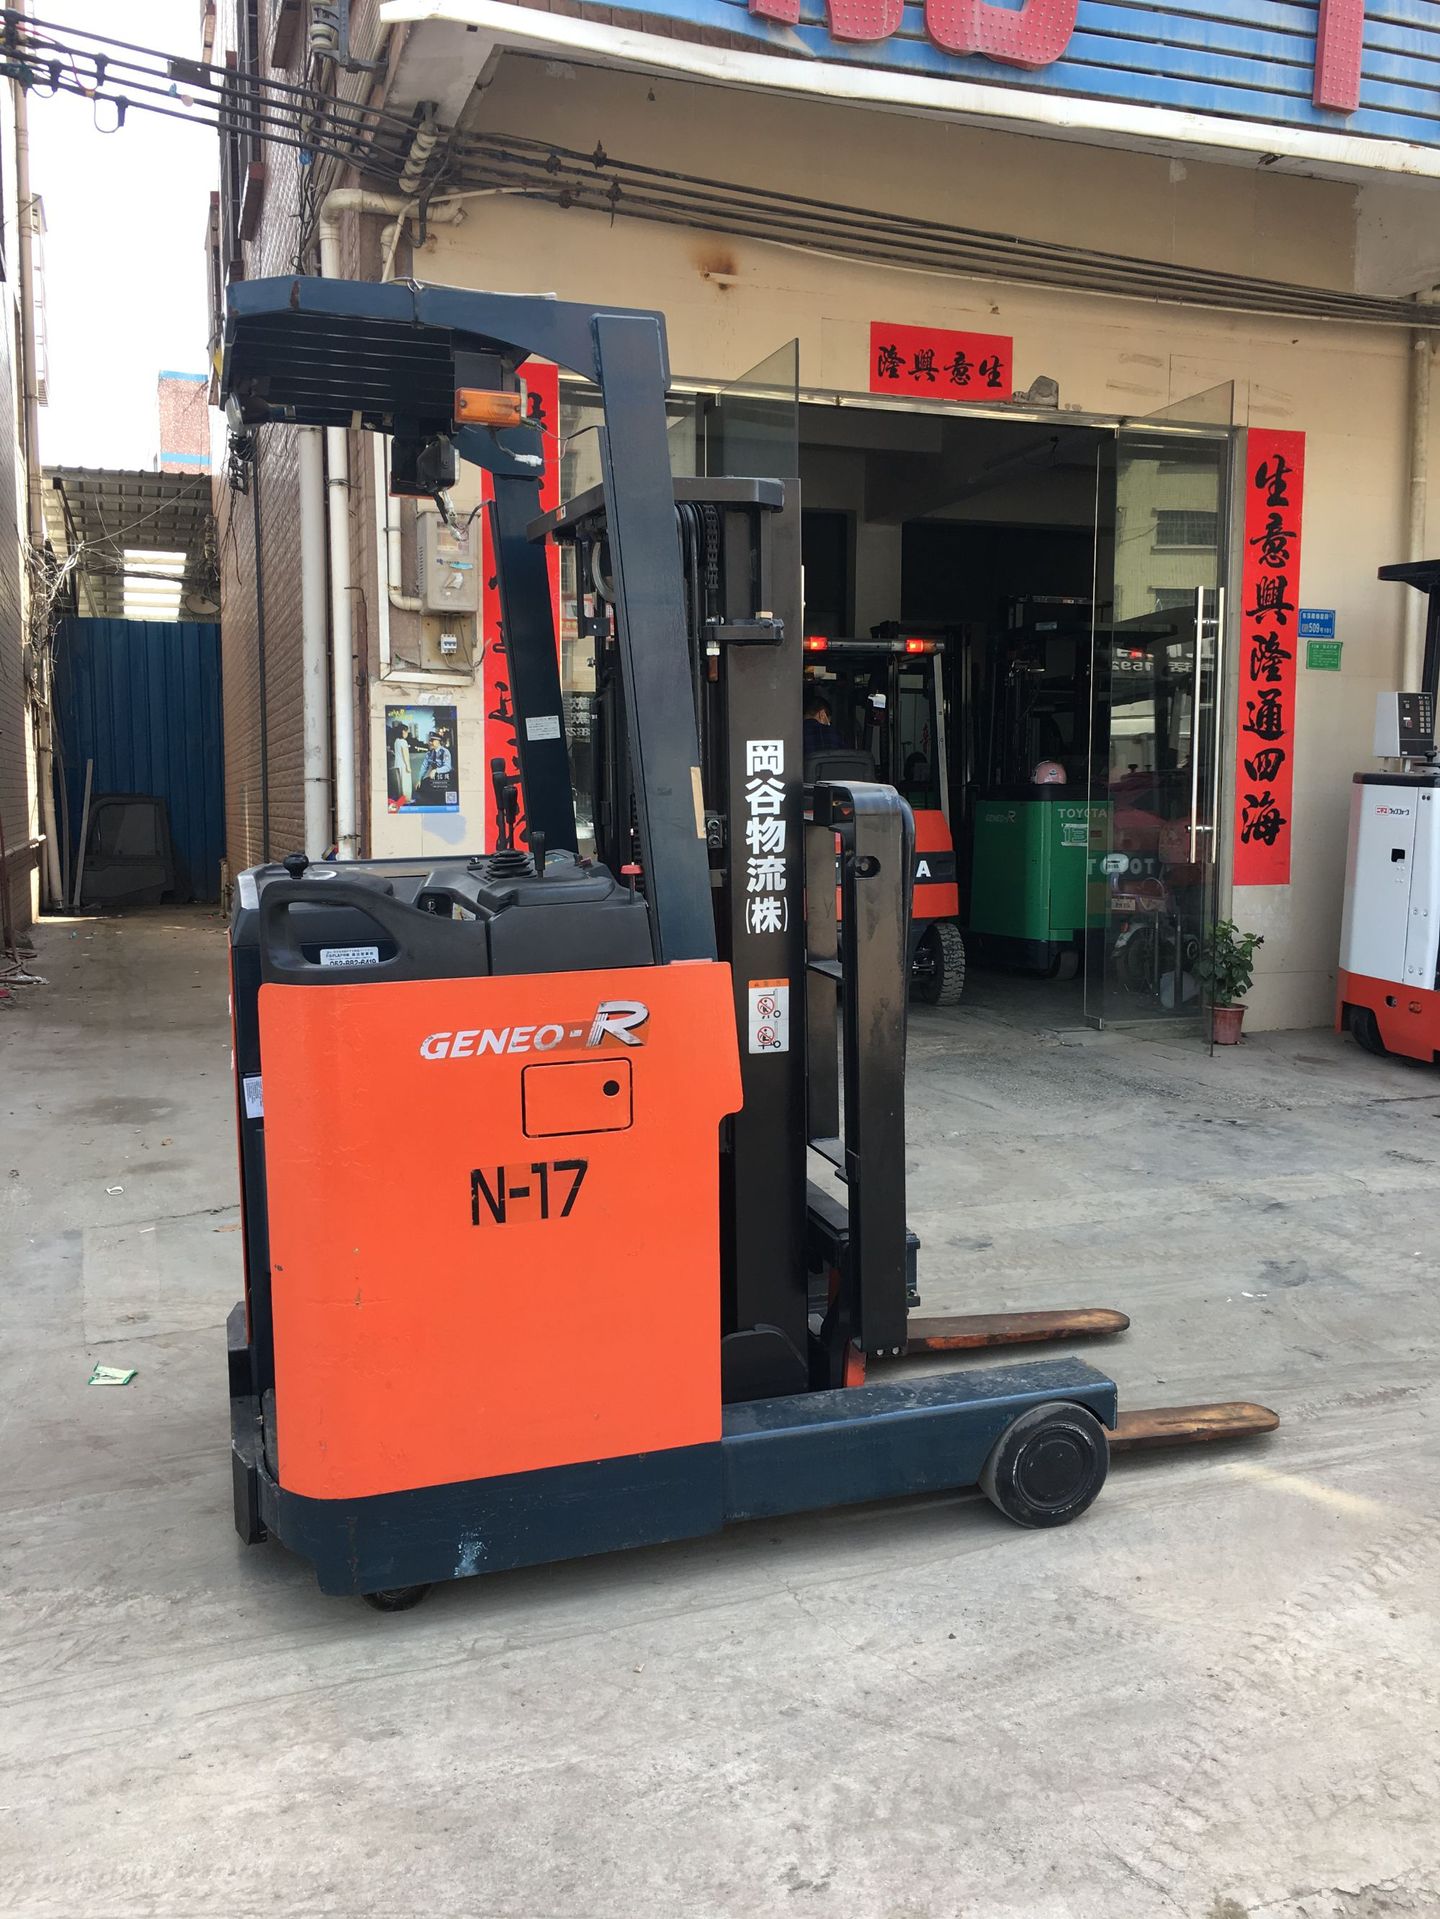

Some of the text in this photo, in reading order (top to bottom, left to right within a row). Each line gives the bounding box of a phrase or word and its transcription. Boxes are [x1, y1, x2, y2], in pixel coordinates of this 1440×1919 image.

[1241, 454, 1298, 847] 生意興隆通四海
[1058, 808, 1107, 819] TOYOTA
[419, 1000, 650, 1061] GENEO-R
[469, 1159, 589, 1226] N-17
